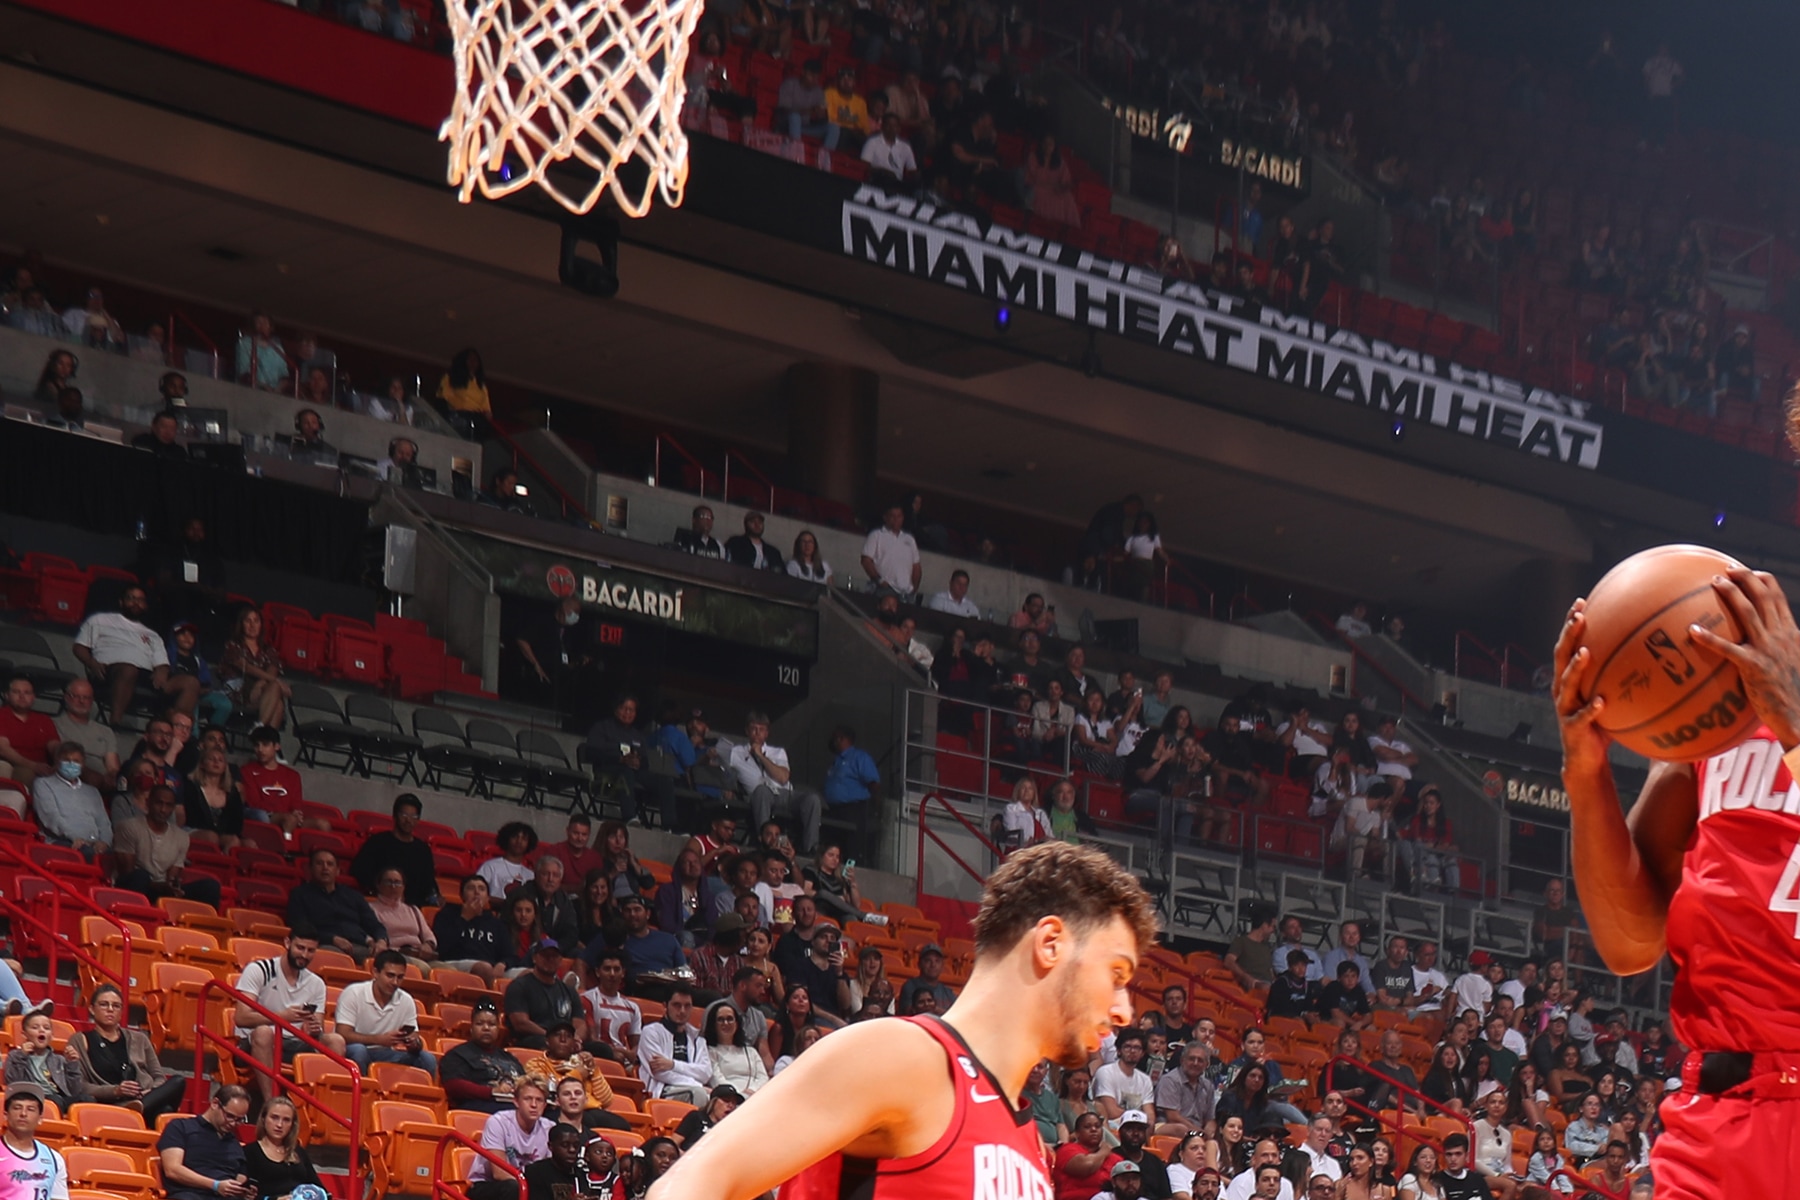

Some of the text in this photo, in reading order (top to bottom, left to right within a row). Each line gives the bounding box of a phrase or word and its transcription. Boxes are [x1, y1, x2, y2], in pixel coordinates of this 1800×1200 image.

[1220, 137, 1303, 190] BACARDÍ
[850, 211, 1595, 466] MIAMI HEAT MIAMI HEAT
[582, 575, 684, 622] BACARDÍ
[600, 624, 624, 646] EXIT
[777, 664, 801, 687] 120
[1649, 678, 1747, 749] ilson
[1506, 778, 1570, 813] BACARD
